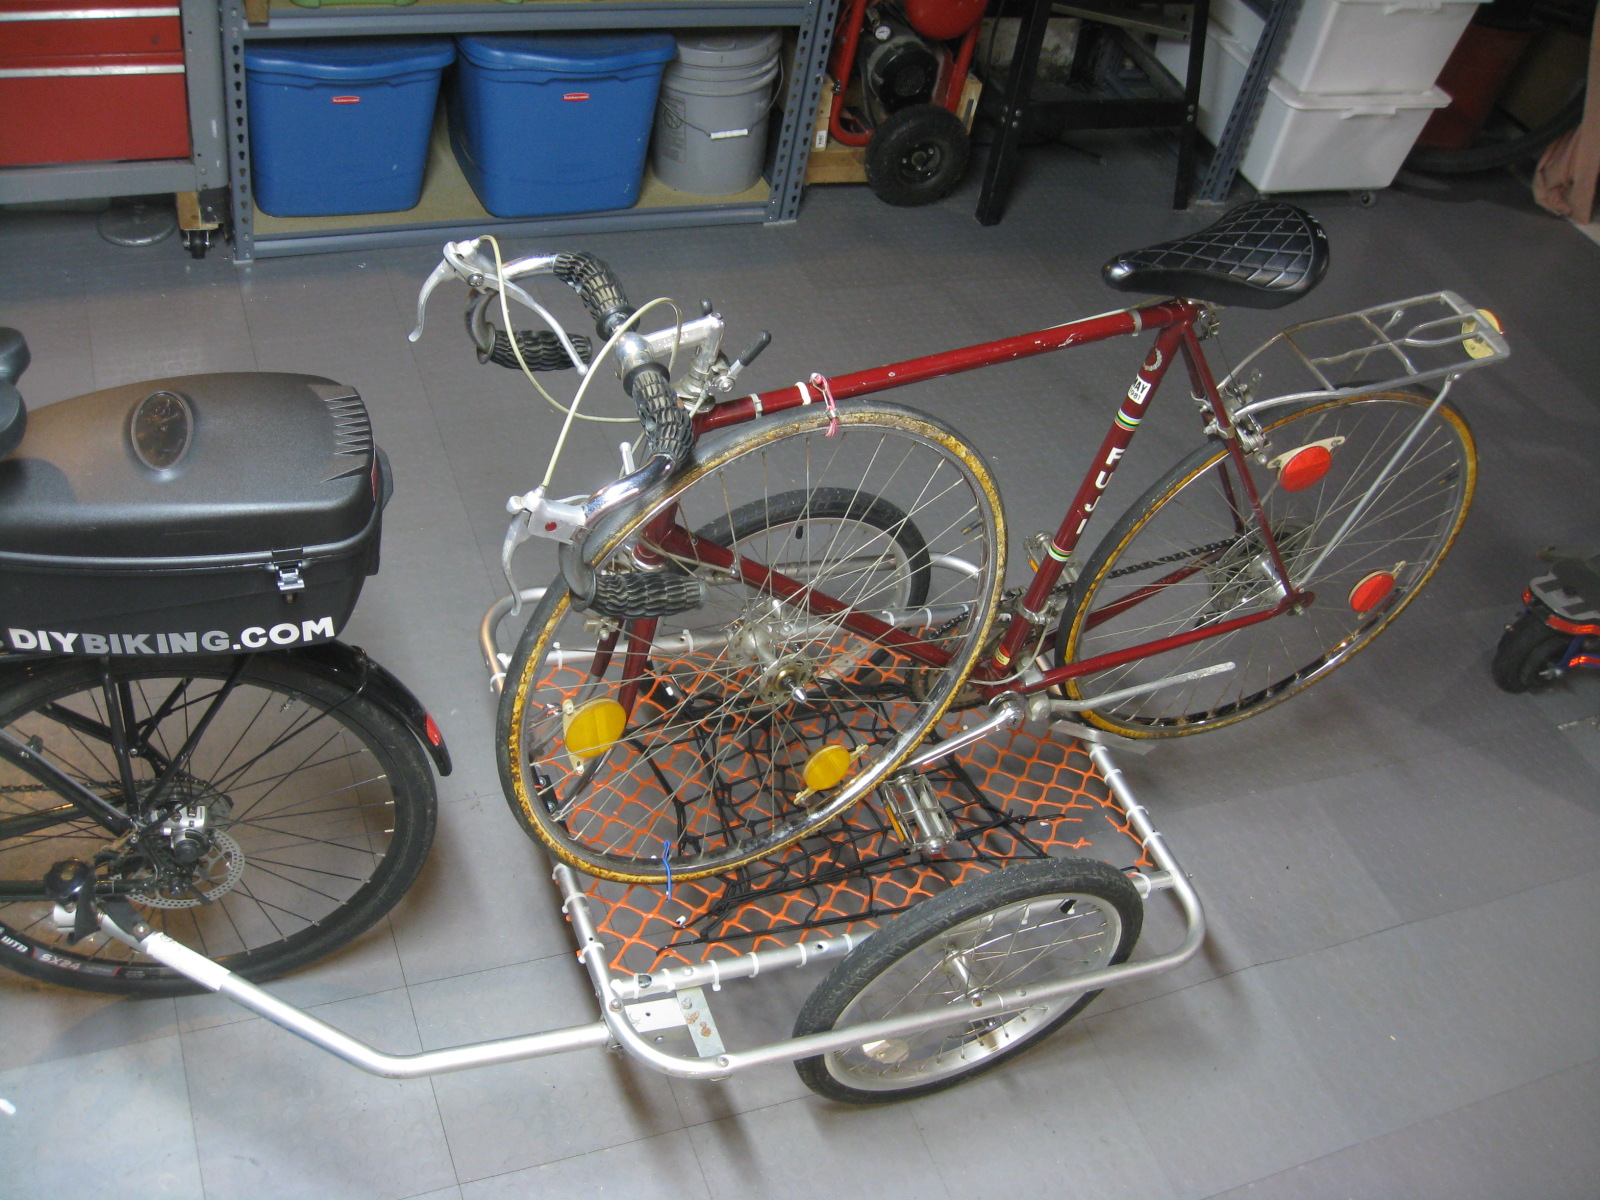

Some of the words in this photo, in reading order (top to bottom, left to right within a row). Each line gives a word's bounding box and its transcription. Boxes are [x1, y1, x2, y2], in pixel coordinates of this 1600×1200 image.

[1076, 447, 1126, 534] FUJI
[9, 616, 335, 654] DIYBIKING.COM
[1, 935, 28, 953] WTB
[39, 953, 81, 970] SX24
